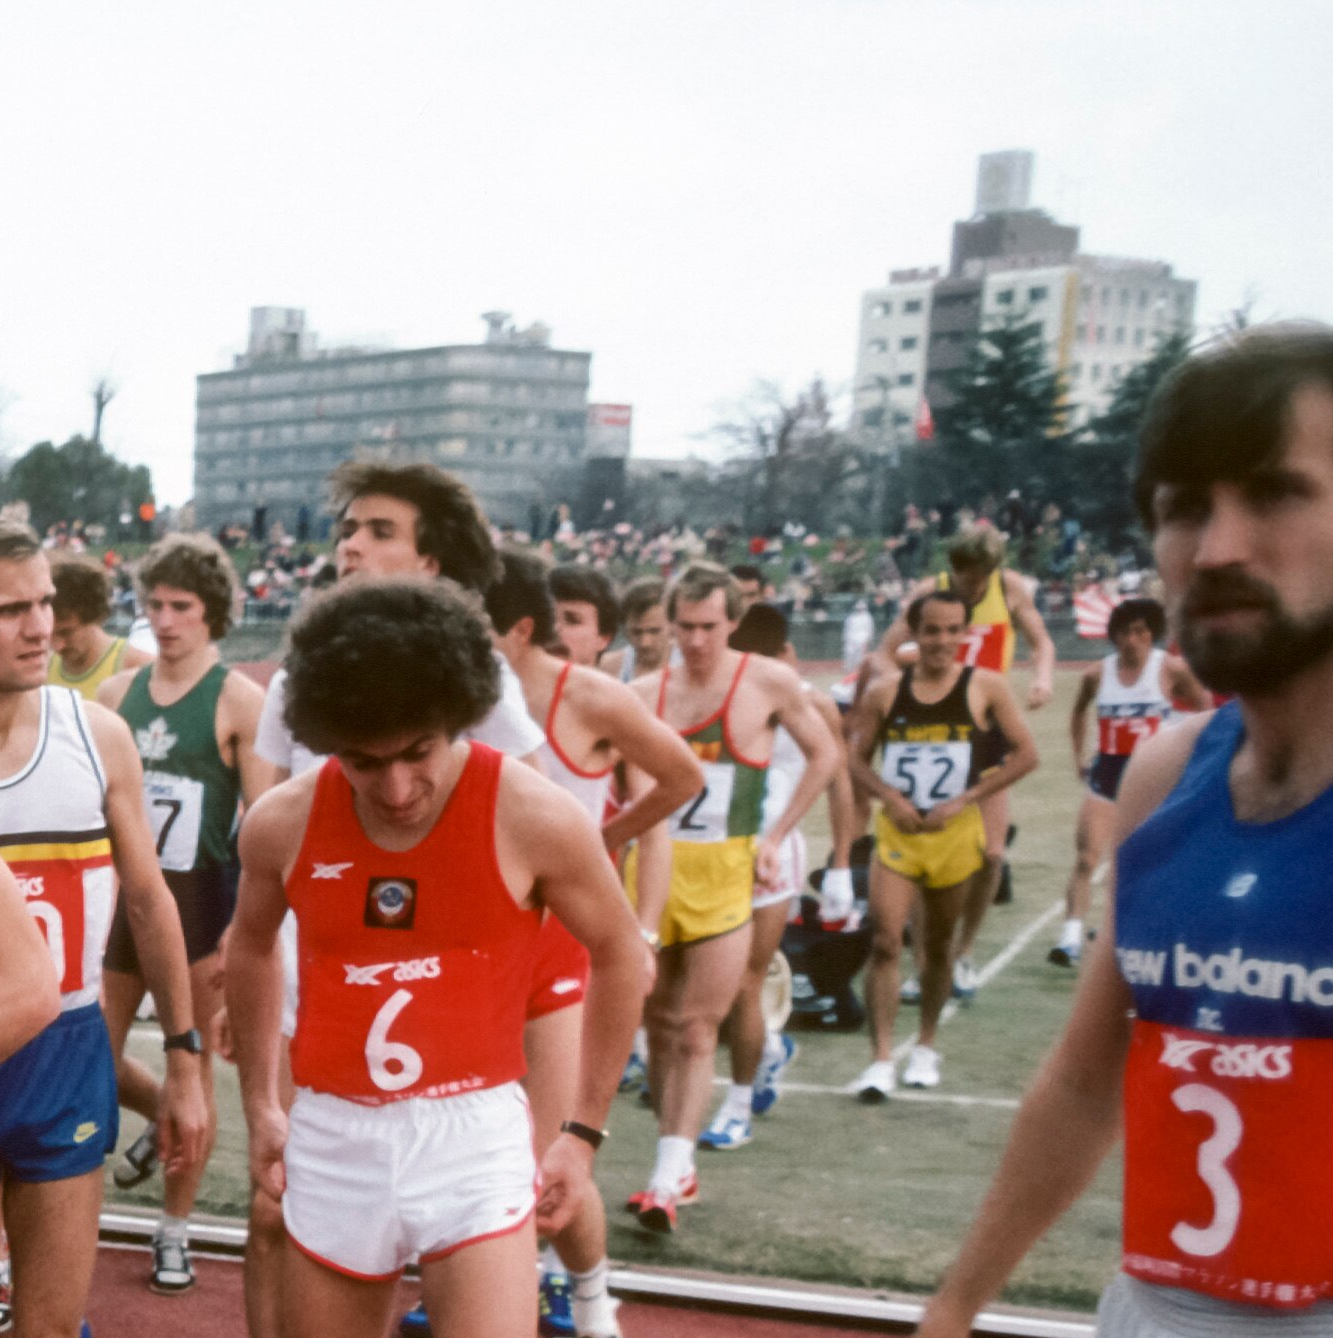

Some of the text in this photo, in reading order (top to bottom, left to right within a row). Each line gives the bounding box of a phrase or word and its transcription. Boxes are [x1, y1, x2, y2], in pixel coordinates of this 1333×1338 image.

[897, 757, 954, 799] 52
[153, 799, 182, 857] 7
[393, 956, 441, 981] asics
[364, 988, 423, 1091] 6
[1210, 1043, 1293, 1079] asics
[1170, 1083, 1243, 1257] 3
